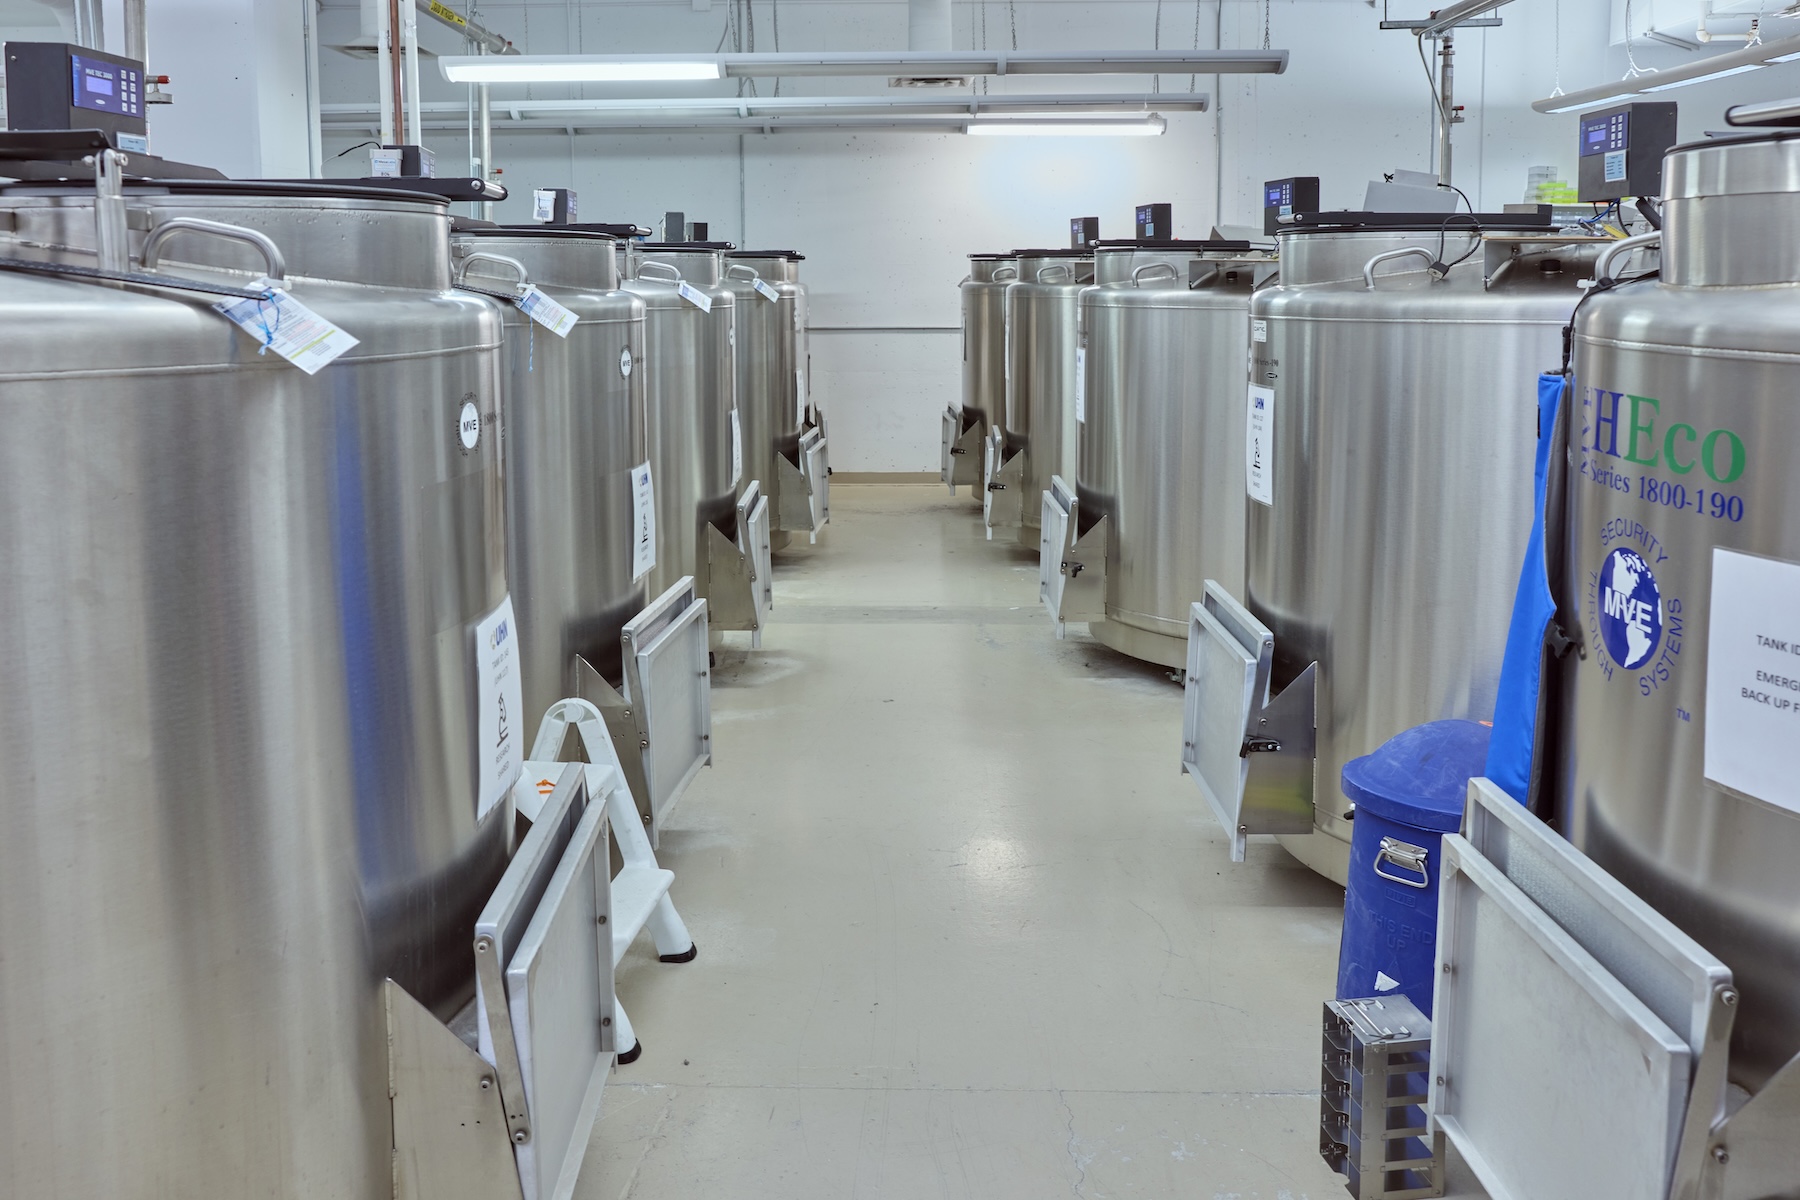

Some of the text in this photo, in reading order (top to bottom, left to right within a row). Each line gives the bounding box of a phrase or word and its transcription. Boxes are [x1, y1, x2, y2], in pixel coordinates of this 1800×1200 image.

[463, 419, 477, 433] MVE
[1590, 459, 1745, 523] Series 1800-190
[1600, 518, 1669, 564] SECURITY
[1604, 586, 1653, 634] MVE
[495, 617, 509, 647] UHN
[1588, 570, 1614, 682] THROUGH
[1639, 598, 1684, 697] SYSTEMS
[1756, 634, 1788, 653] TANK
[1756, 670, 1800, 693] EMERG
[1741, 687, 1771, 706] BACK
[1773, 697, 1791, 711] UP
[1387, 934, 1406, 952] UP
[1401, 923, 1434, 945] END
